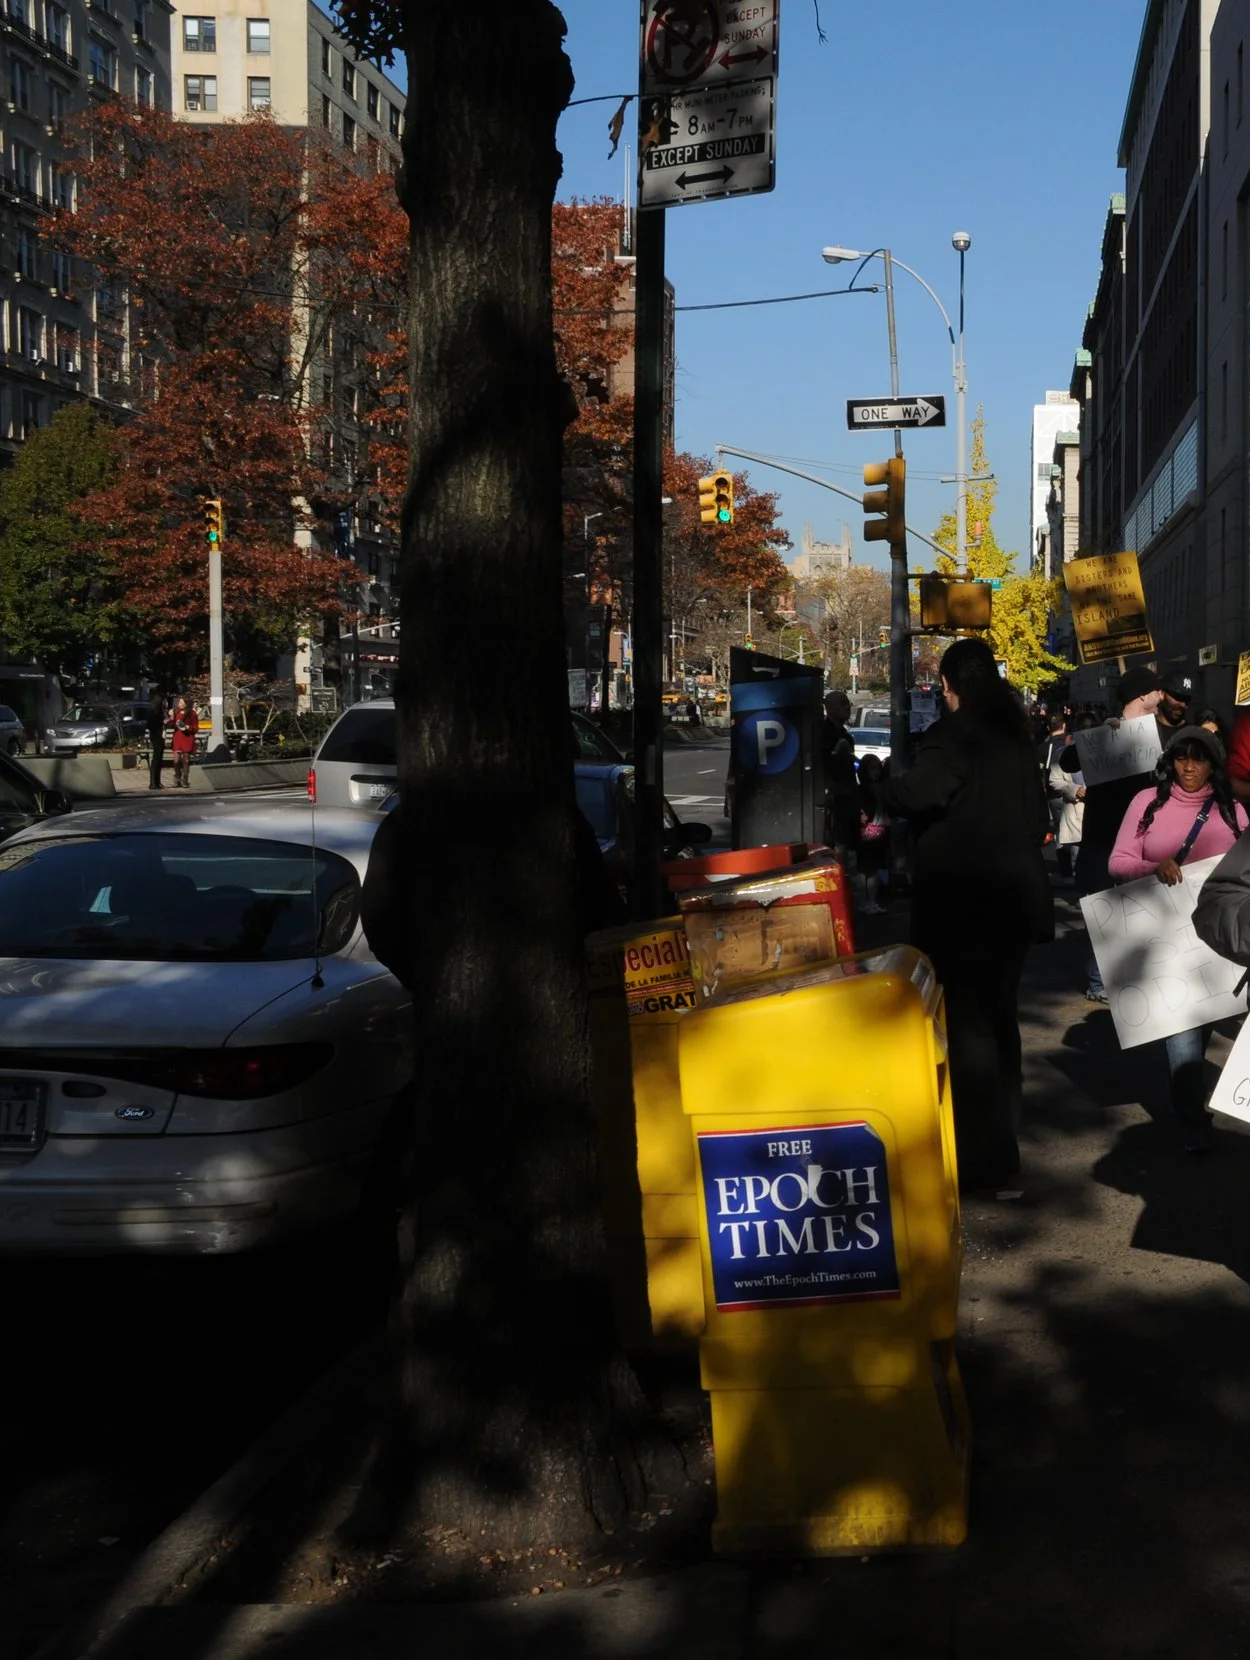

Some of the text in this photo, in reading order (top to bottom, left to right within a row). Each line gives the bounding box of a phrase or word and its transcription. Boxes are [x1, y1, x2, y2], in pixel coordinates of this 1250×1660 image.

[726, 6, 766, 24] EXCEPT
[725, 26, 766, 44] SUNDAY
[651, 136, 759, 169] EXCEPT SUNDAY
[860, 405, 930, 421] ONE WAY
[1075, 566, 1132, 584] SISTERS AND
[1077, 608, 1120, 625] ISLAND
[645, 991, 695, 1013] GRAT
[121, 1106, 149, 1119] Ford
[767, 1139, 813, 1157] FREE
[715, 1165, 880, 1216] EPOCH
[718, 1211, 880, 1260] TIMES
[733, 1270, 877, 1289] www.TheEpochTimes.com
